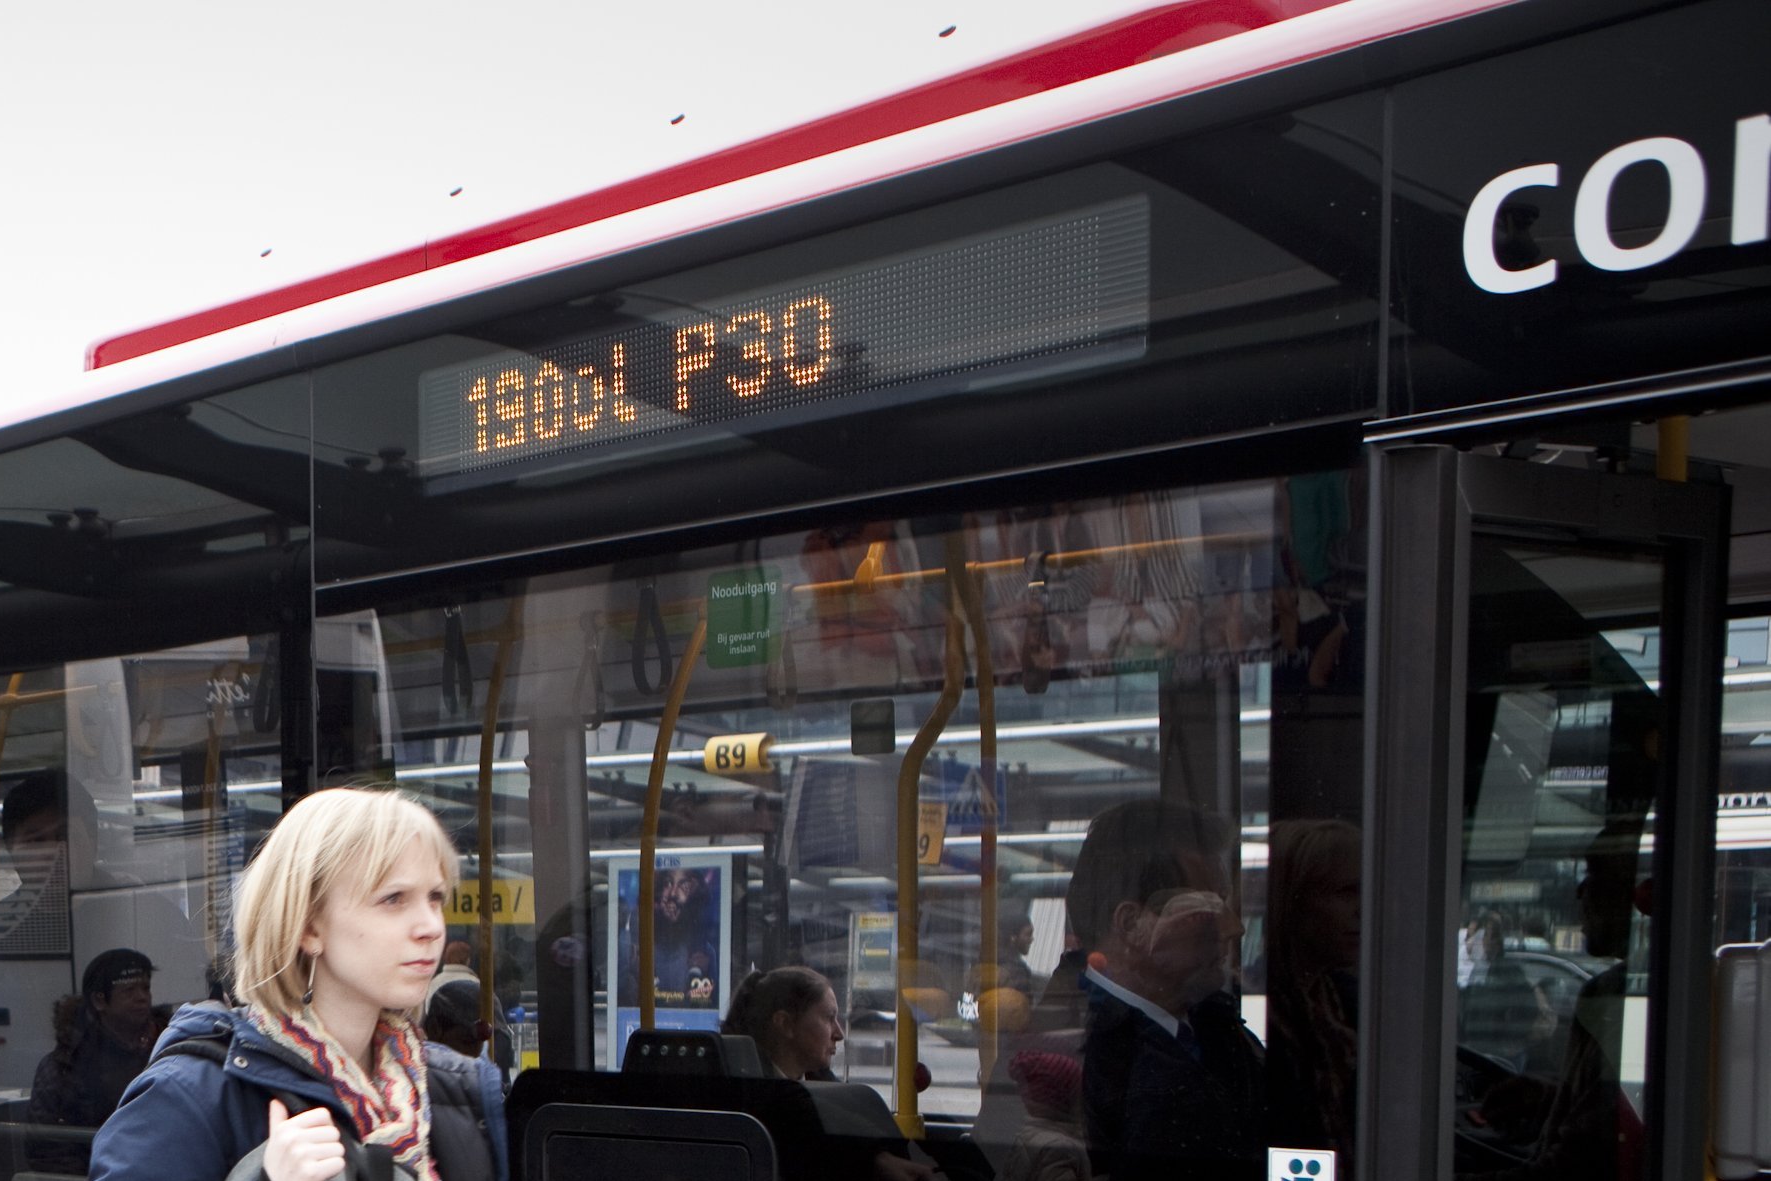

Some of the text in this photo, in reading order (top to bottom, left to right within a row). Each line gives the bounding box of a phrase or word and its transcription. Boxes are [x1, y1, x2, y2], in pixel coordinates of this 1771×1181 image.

[676, 296, 830, 412] P30
[711, 582, 777, 599] Nooduitgang
[728, 632, 756, 644] gevaar
[729, 645, 756, 654] inslaan
[716, 743, 746, 768] B9
